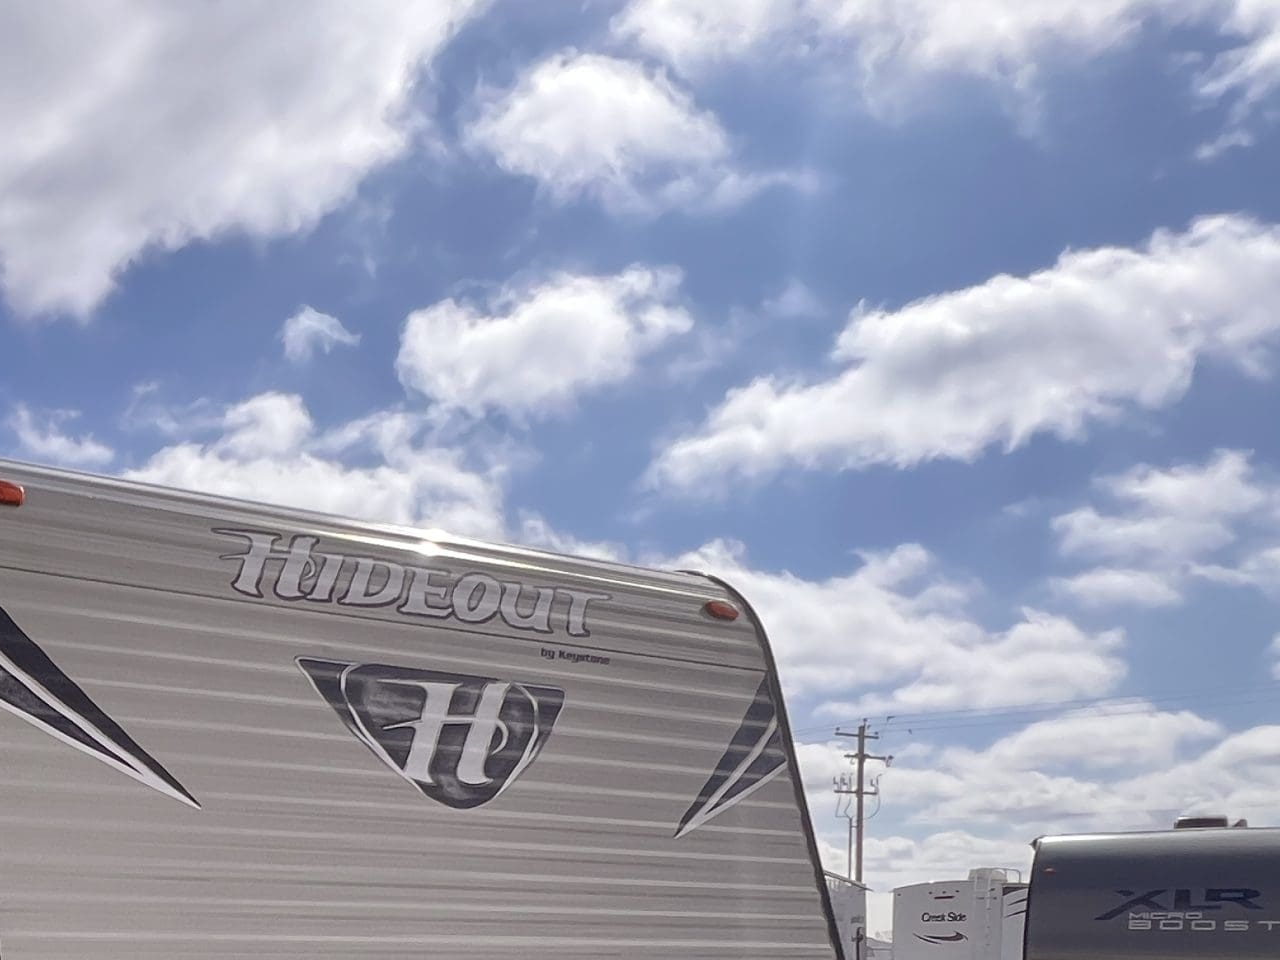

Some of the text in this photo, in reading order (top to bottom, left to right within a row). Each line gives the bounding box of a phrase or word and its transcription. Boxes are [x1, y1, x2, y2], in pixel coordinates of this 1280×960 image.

[211, 527, 613, 638] HIDEOUT
[540, 647, 610, 666] by Keystone
[1094, 888, 1264, 920] XLR
[1127, 919, 1280, 931] BOOST
[1128, 911, 1202, 920] MICRO
